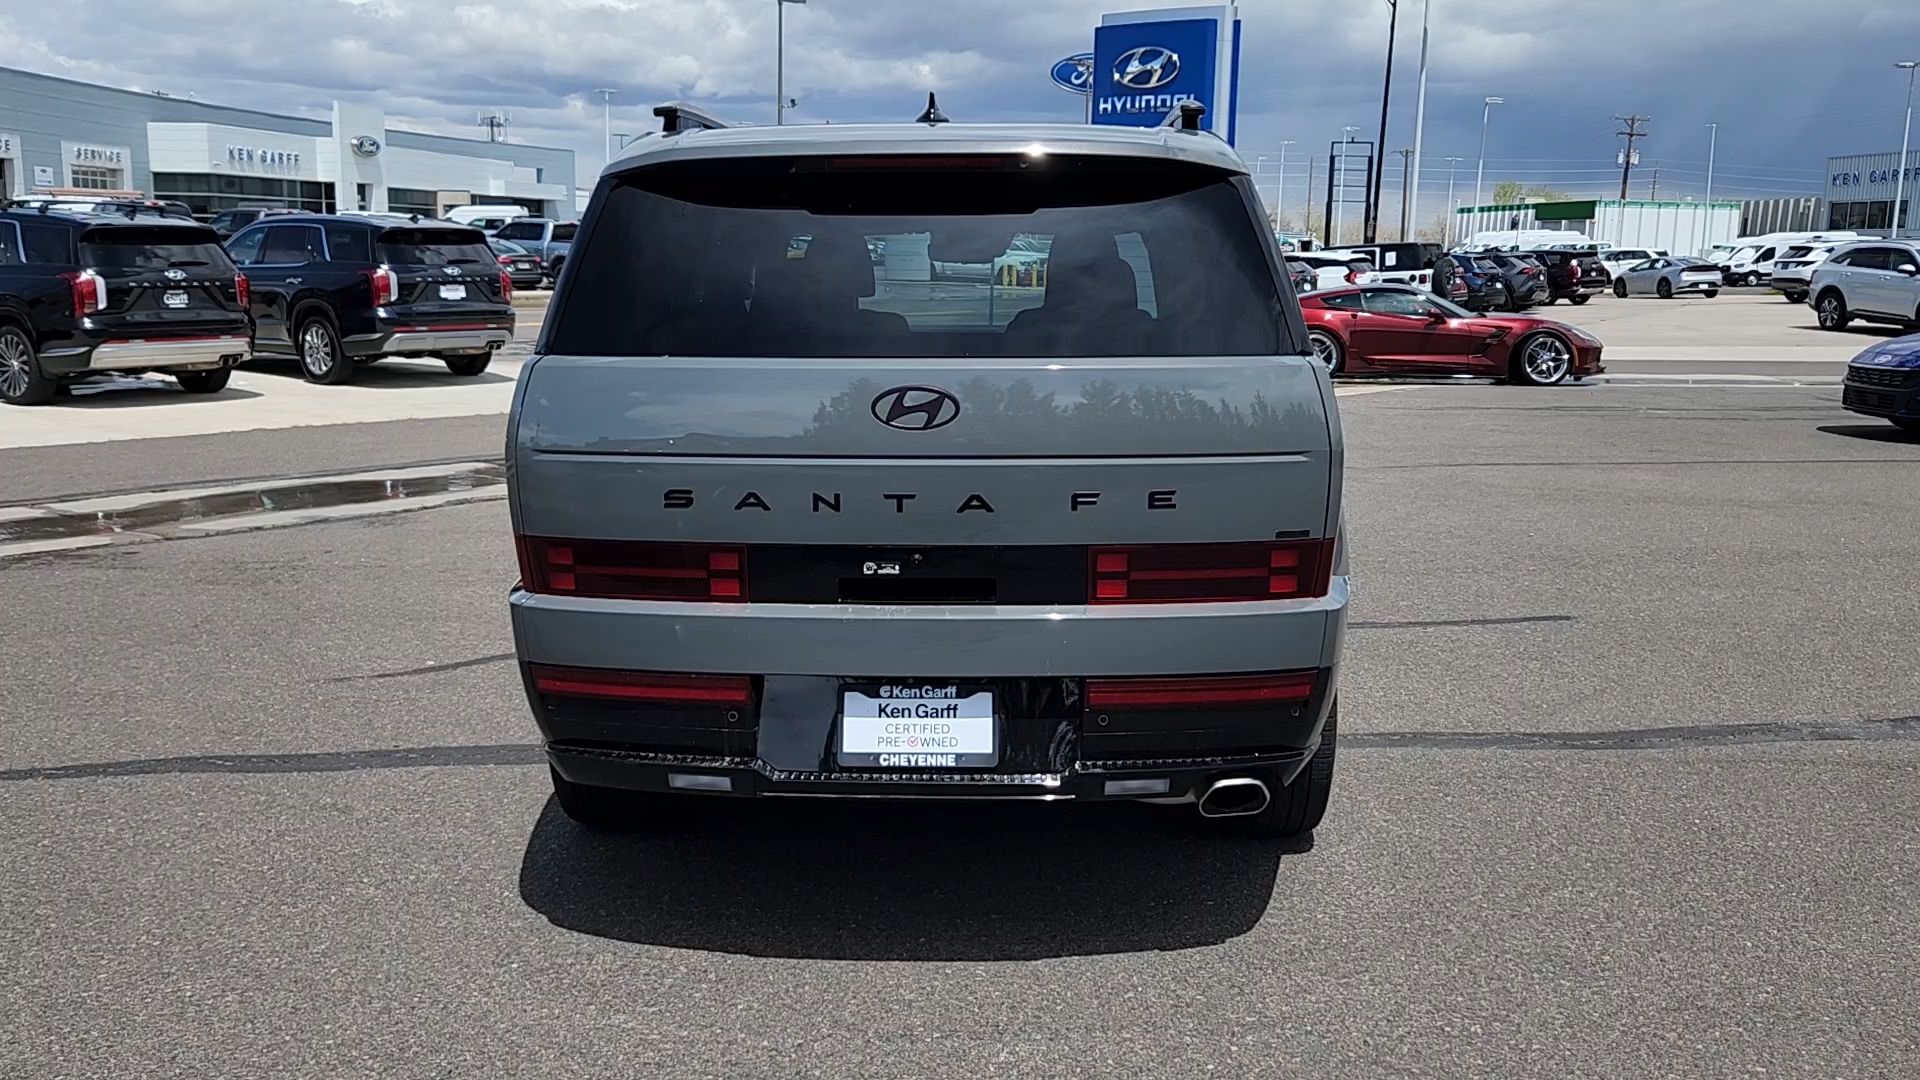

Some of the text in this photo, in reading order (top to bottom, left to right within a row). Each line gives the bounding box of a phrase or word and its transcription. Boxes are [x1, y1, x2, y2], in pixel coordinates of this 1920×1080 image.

[75, 147, 122, 163] SERVICE
[227, 146, 300, 165] KEN GARFF
[1832, 171, 1861, 186] KEN
[662, 488, 1178, 514] SANTA FE
[892, 686, 957, 698] Ken Garff
[877, 703, 959, 719] Ken Garff
[884, 723, 951, 735] CERTIFIED
[879, 754, 956, 767] CHEYENNE
